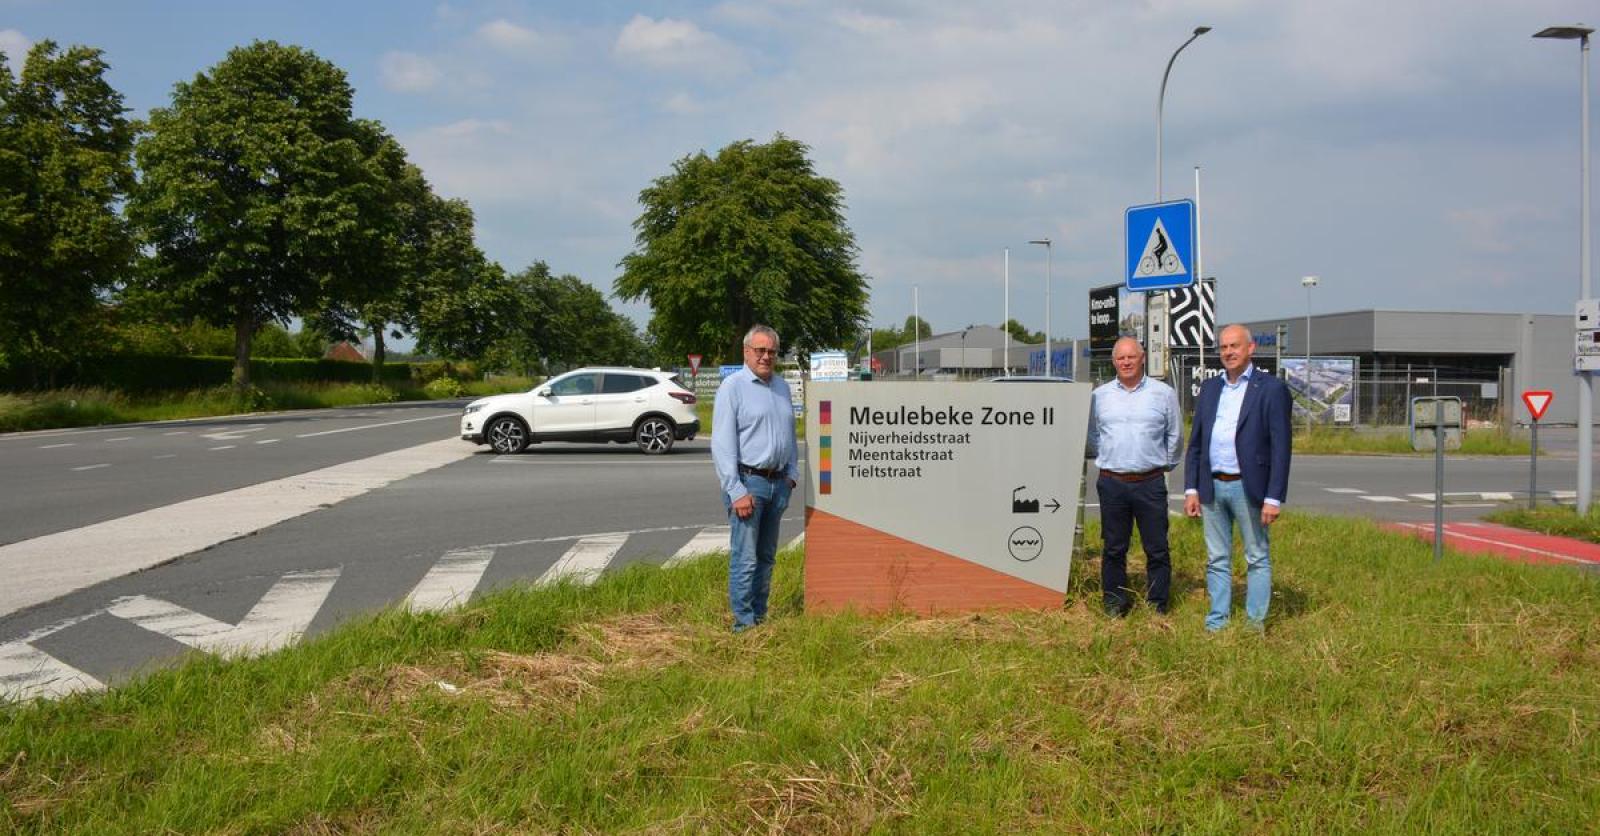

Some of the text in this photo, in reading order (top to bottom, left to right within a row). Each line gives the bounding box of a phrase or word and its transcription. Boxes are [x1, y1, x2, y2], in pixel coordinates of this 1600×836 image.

[850, 405, 1054, 426] Meulebeke Zone II
[848, 430, 971, 447] Nijverheidsstraat
[848, 447, 954, 461] Meentakstraat
[848, 464, 922, 479] Tieltstraat
